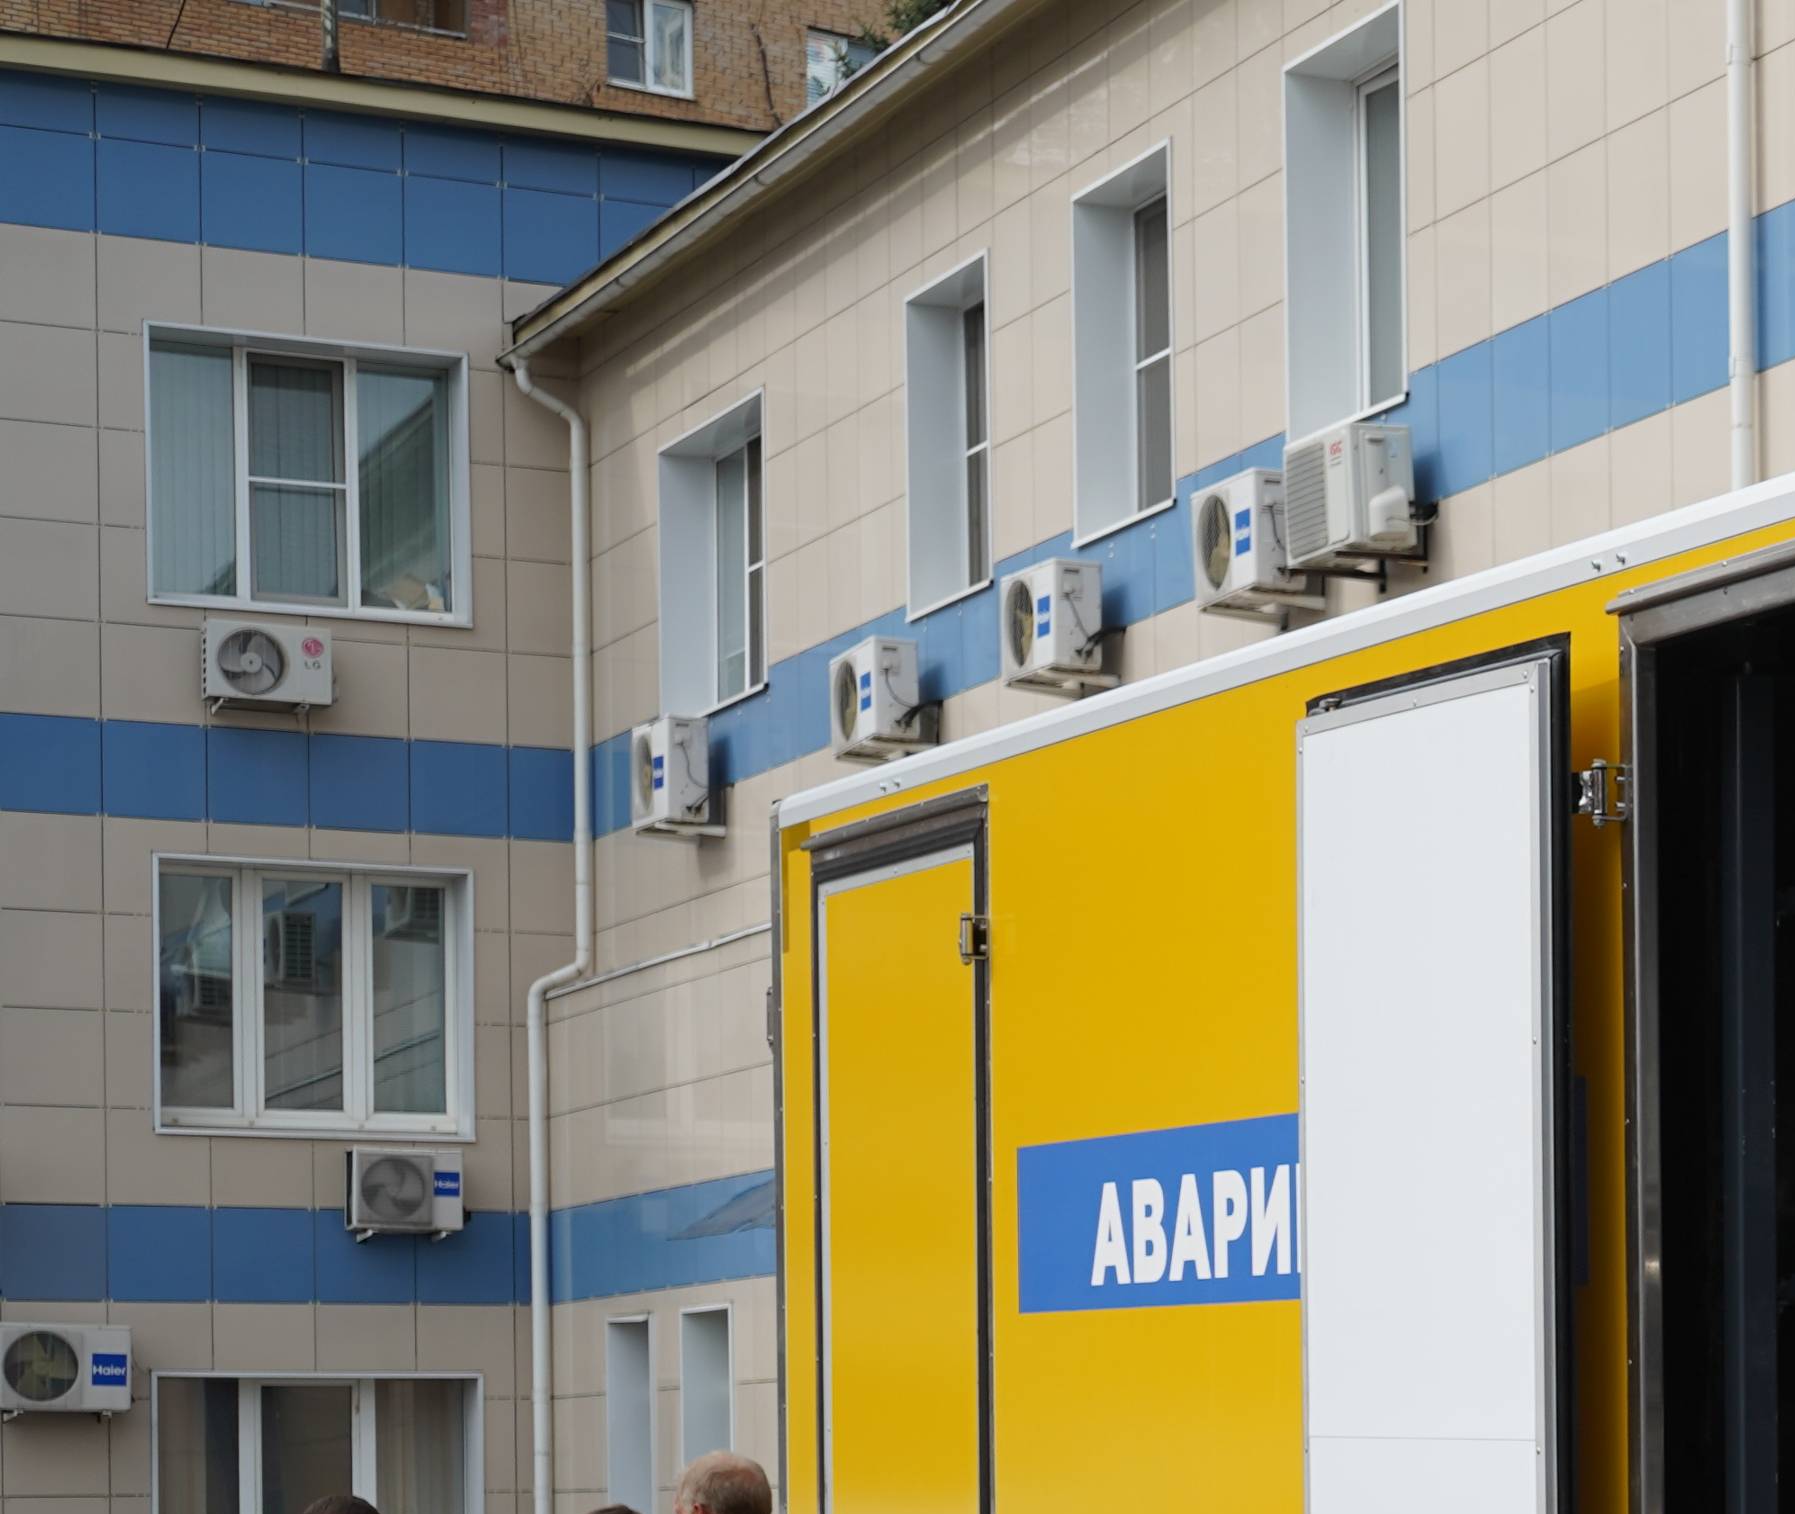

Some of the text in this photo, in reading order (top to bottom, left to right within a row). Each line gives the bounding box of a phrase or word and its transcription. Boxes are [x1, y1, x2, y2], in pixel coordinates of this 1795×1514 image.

[304, 660, 321, 671] LG
[1091, 1162, 1301, 1287] АВАРИ
[93, 1363, 126, 1376] Haier
